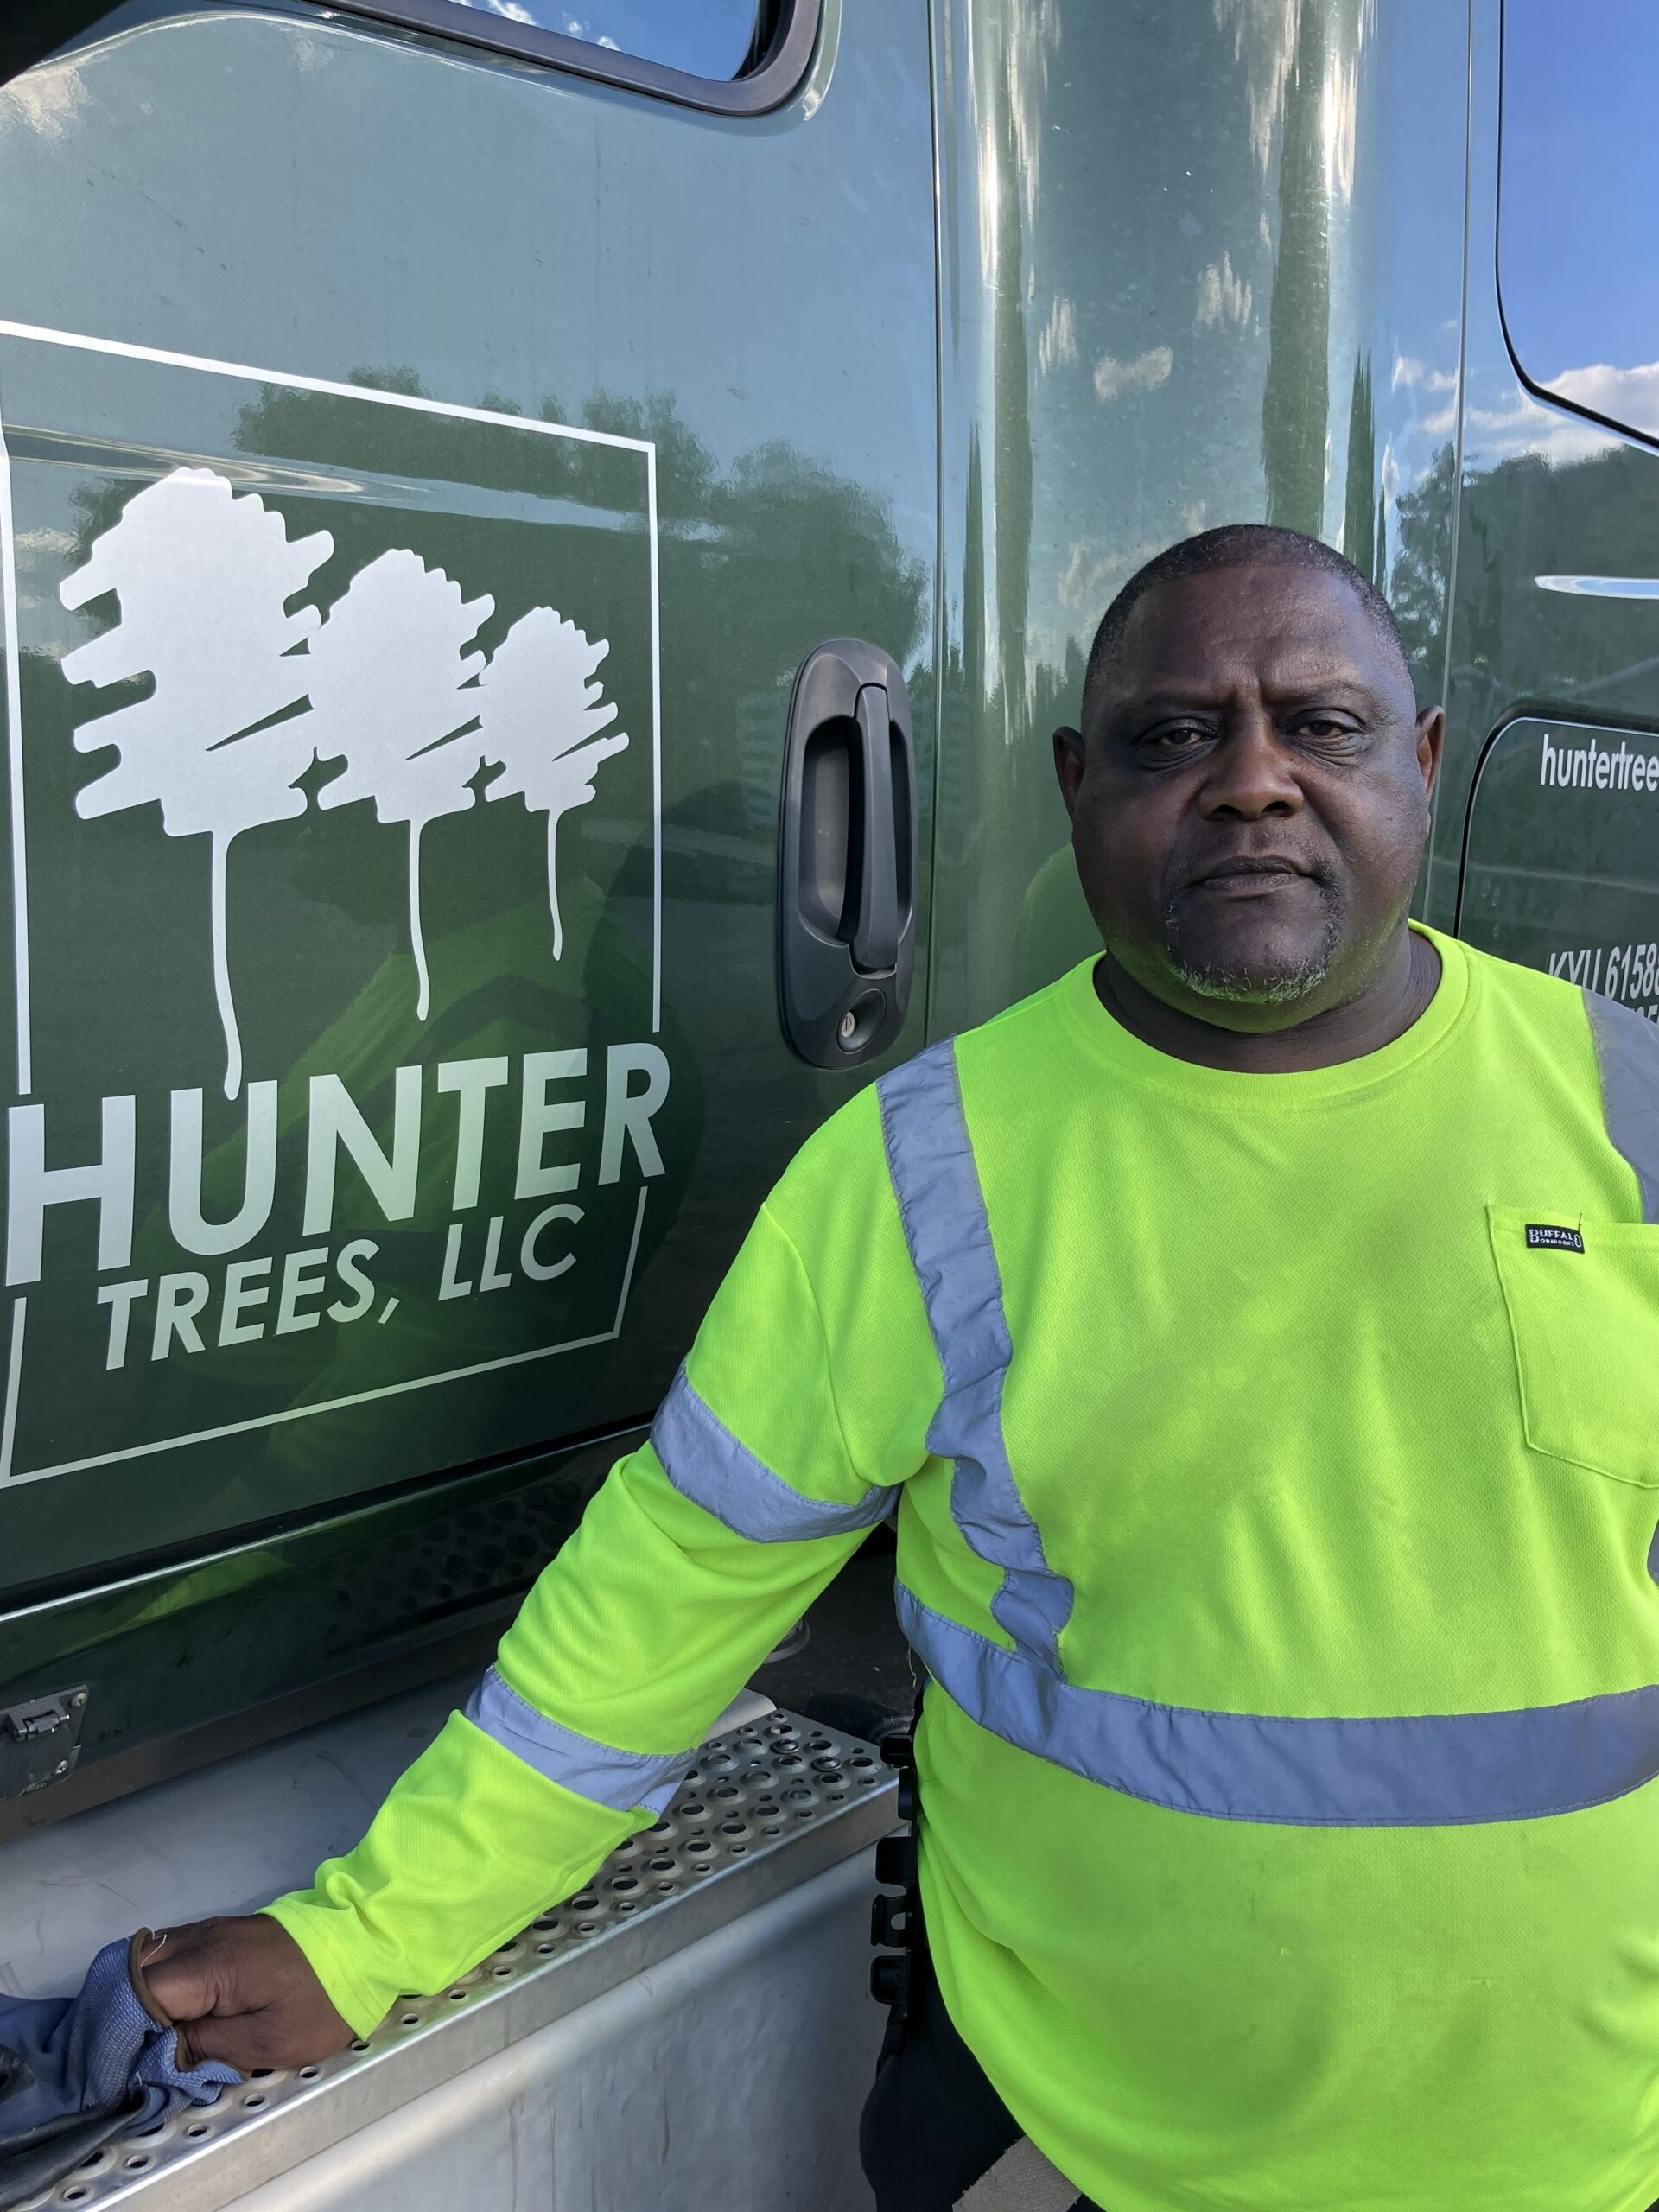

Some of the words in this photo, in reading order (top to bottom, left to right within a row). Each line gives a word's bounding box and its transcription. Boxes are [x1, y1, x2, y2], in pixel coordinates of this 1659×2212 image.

[1605, 942, 1659, 1001] 6158
[5, 1042, 671, 1287] HUNTER
[97, 1238, 401, 1370] TREES,
[437, 1203, 585, 1301] LLC
[1529, 1228, 1582, 1248] BUFFALO
